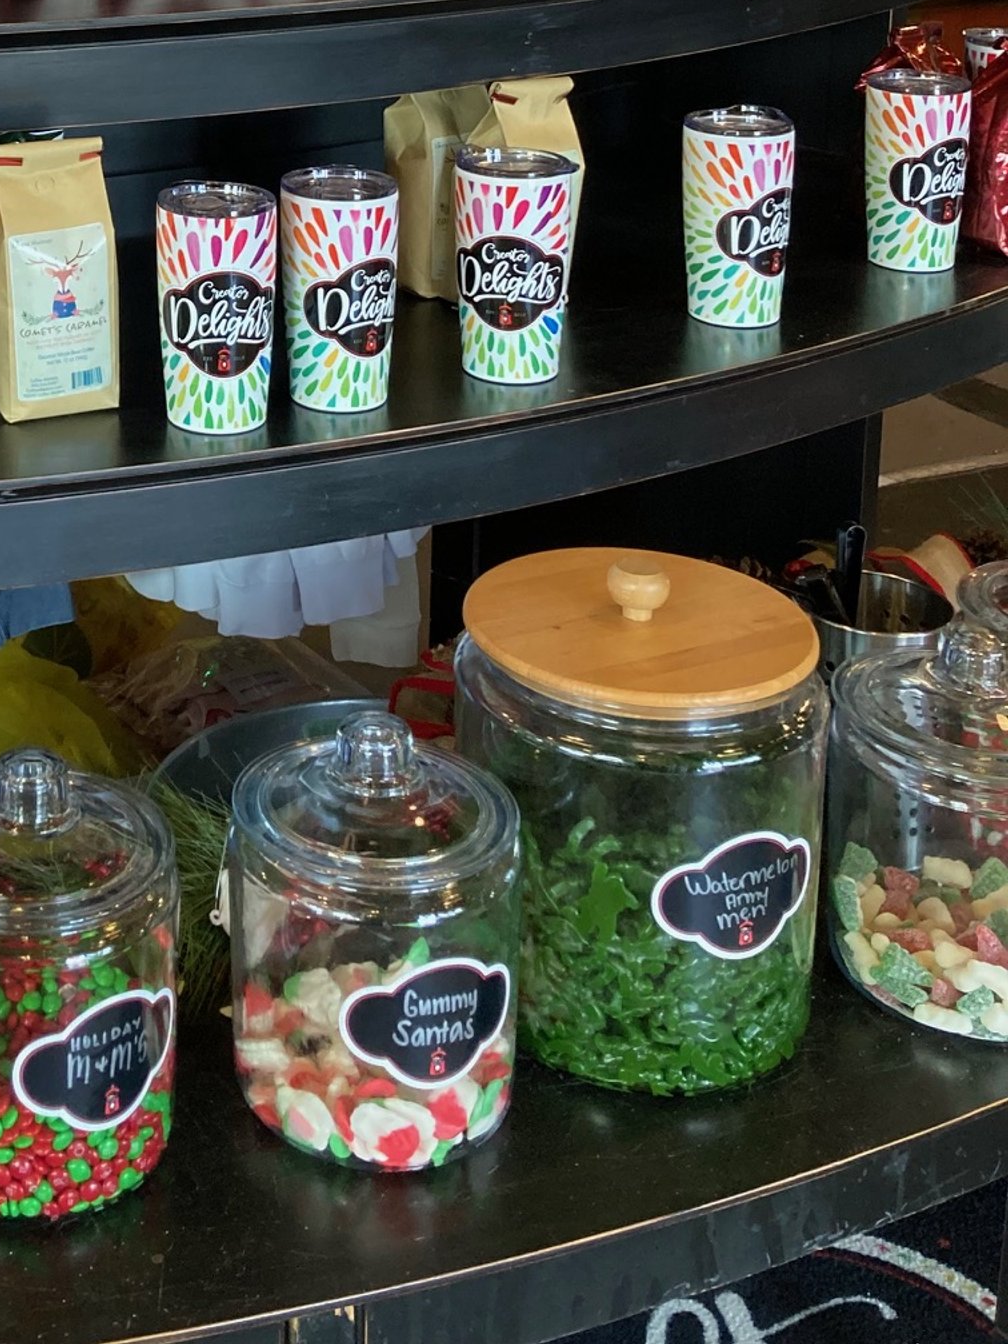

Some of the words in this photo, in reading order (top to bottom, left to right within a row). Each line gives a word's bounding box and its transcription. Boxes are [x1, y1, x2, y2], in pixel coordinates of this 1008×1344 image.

[481, 243, 530, 264] Creator
[198, 281, 249, 305] Creator
[460, 254, 561, 303] Delights
[170, 296, 272, 346] Delights
[685, 854, 798, 896] Watermelon
[725, 887, 769, 911] Army
[716, 905, 766, 931] men
[404, 989, 478, 1018] Gummy
[71, 1016, 141, 1052] HOLIDAY
[393, 1018, 475, 1047] Santas
